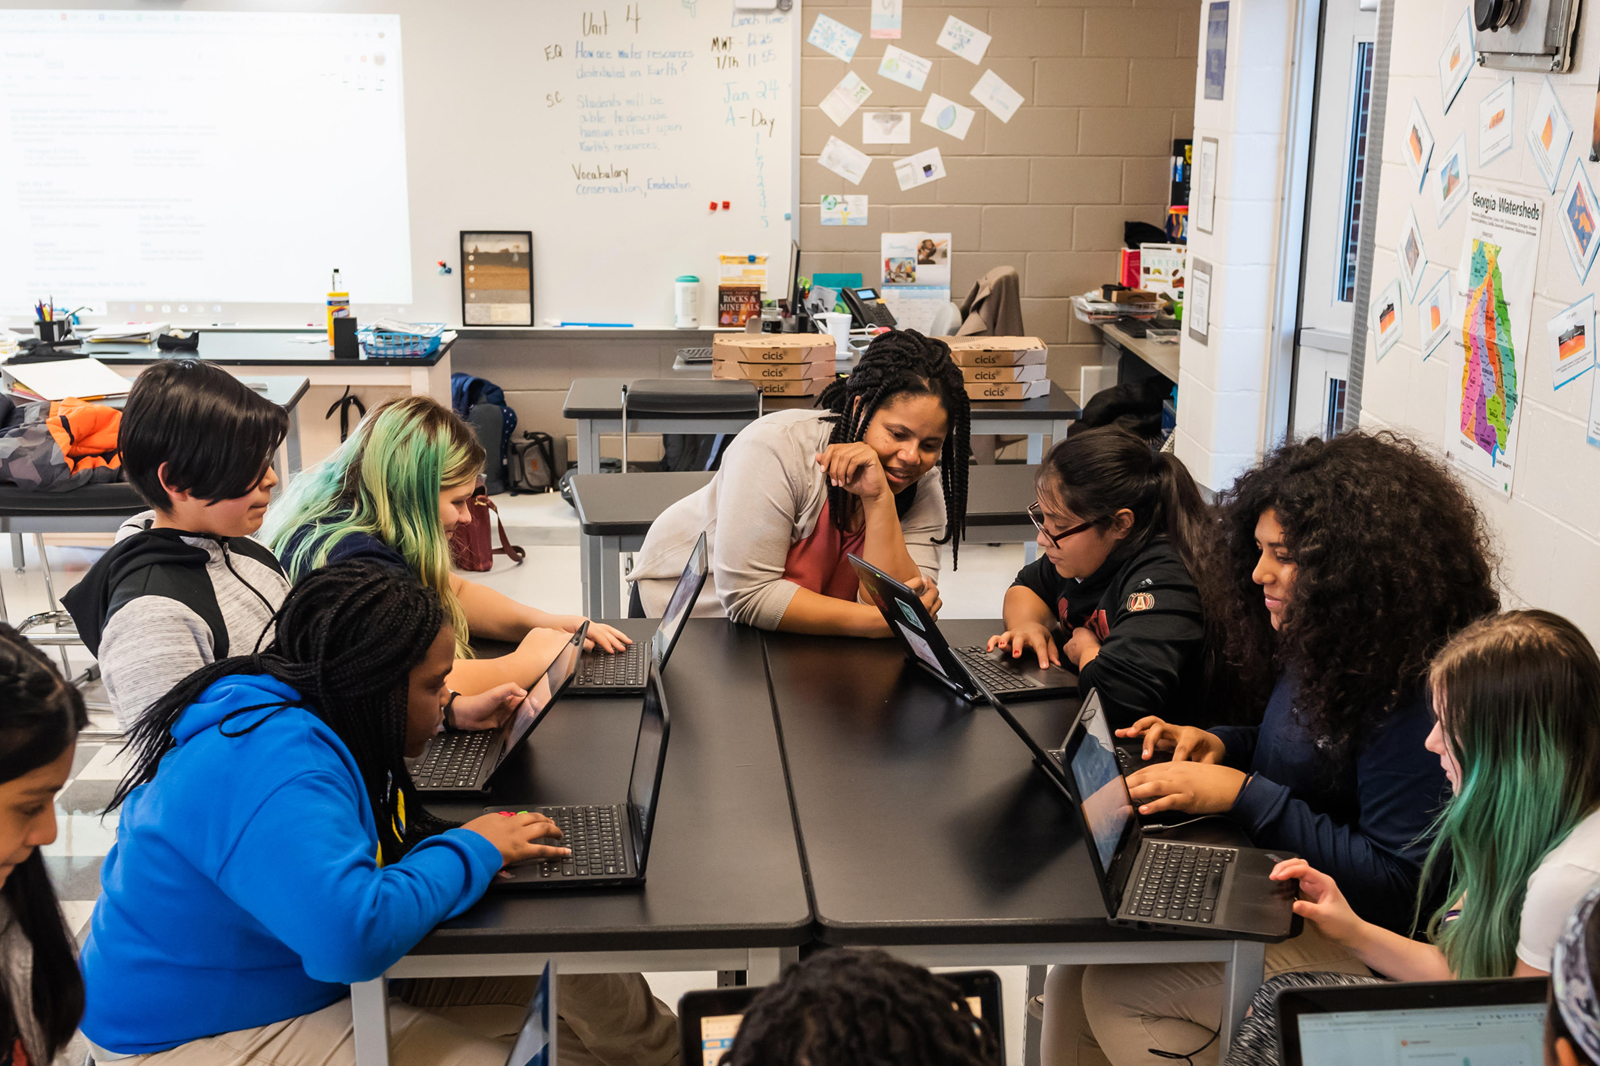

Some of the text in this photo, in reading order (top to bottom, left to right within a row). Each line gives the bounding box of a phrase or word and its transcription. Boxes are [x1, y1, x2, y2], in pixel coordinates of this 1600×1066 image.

[582, 2, 641, 37] Unit 4
[575, 40, 593, 59] How
[596, 49, 612, 59] are
[647, 48, 694, 59] resources
[723, 79, 780, 104] Jan 24
[649, 92, 665, 105] be
[725, 106, 736, 128] A
[751, 108, 775, 138] Day
[571, 163, 629, 184] Vocabulary
[1472, 191, 1540, 221] Georgia Watersheds
[723, 295, 757, 303] ROCKS &
[720, 303, 760, 311] MINERALS
[762, 352, 784, 360] cicis
[975, 355, 996, 364] cicis
[762, 368, 784, 377] cicis
[975, 372, 996, 380] cicis
[764, 384, 785, 393] cicis
[984, 388, 1005, 397] cicis
